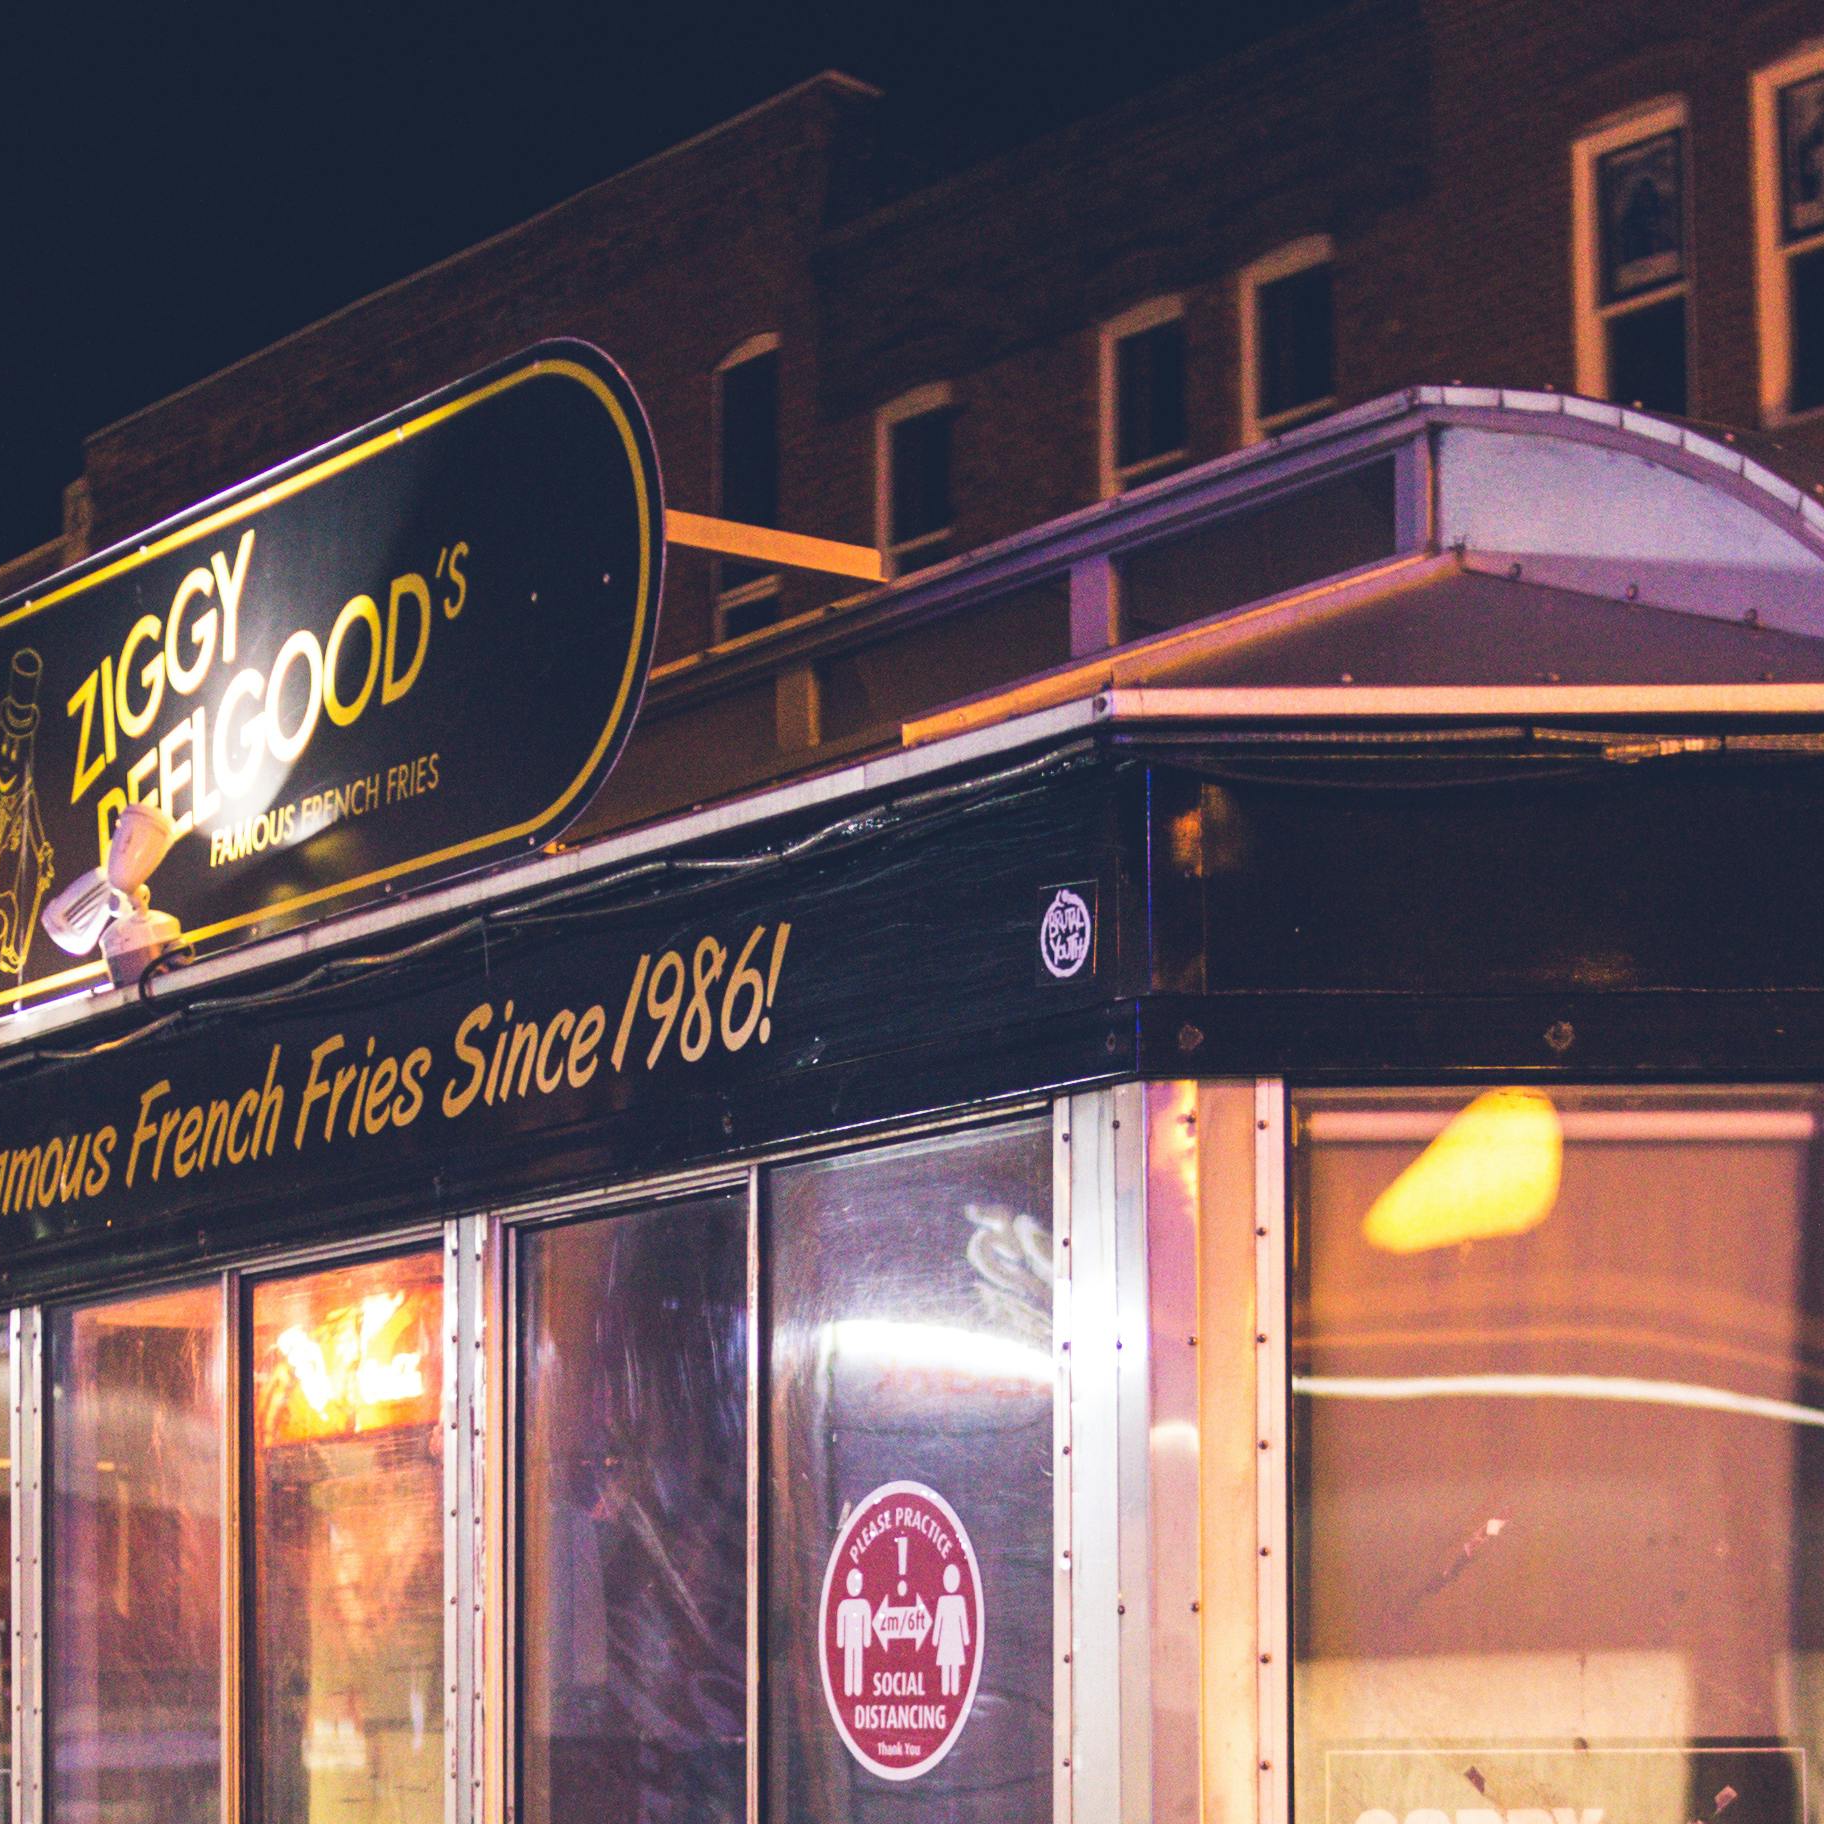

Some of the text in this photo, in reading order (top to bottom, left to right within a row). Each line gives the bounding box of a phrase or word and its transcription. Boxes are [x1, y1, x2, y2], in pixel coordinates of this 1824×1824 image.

[67, 529, 255, 804] ZIGGY
[210, 753, 441, 868] FAMOUS FRENCH FRIES
[126, 1044, 284, 1188] French
[294, 1034, 432, 1150] Fries
[442, 1000, 606, 1118] Since
[611, 922, 791, 1072] 1986!
[848, 1506, 953, 1564] PLEASE PRACTICE
[873, 1671, 926, 1697] SOCIAL
[855, 1704, 947, 1730] DISTANCING
[878, 1742, 922, 1757] Thank You
